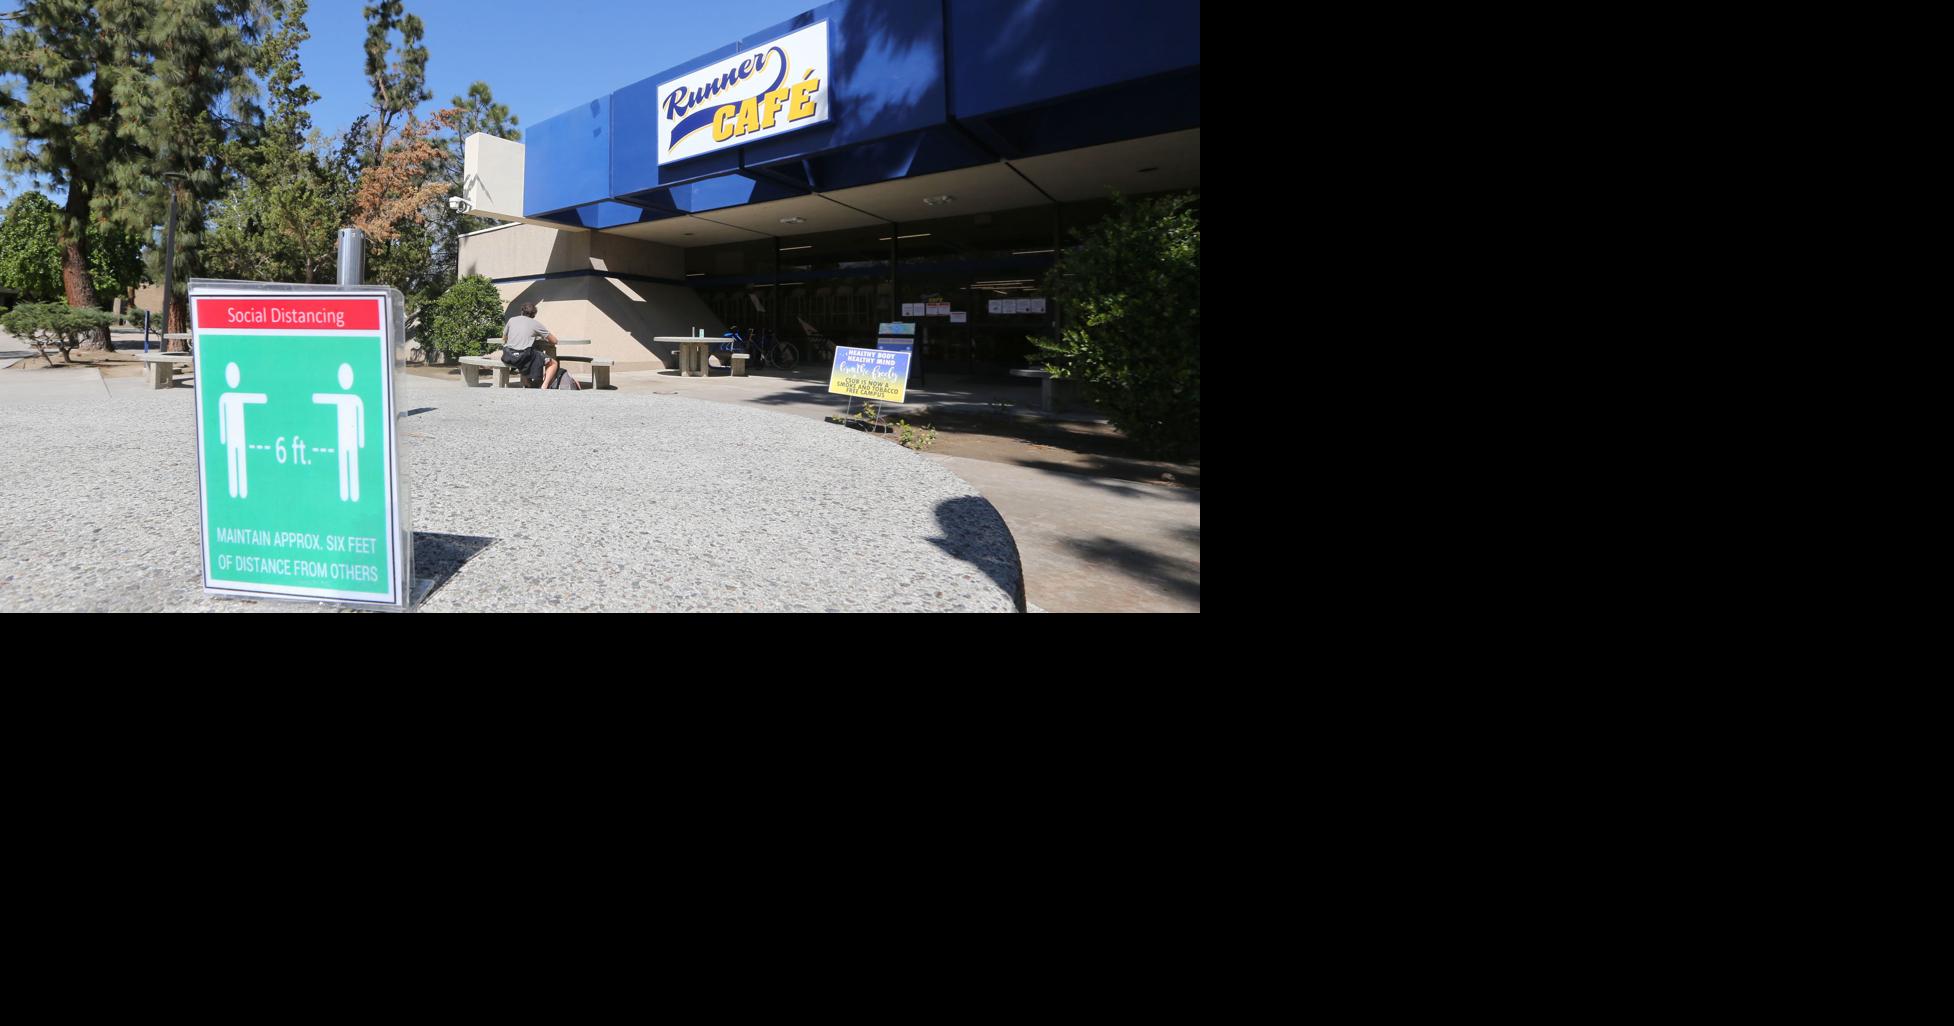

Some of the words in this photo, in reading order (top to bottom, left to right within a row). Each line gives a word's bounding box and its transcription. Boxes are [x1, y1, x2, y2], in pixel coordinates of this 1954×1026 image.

[663, 51, 768, 120] Runner
[712, 68, 820, 142] CAFÉ
[227, 307, 267, 323] Social
[271, 308, 345, 327] Distancing
[847, 356, 874, 364] HEALTHY
[868, 379, 884, 387] NOW
[872, 385, 899, 395] TOBACCO
[275, 436, 287, 464] 6
[292, 435, 312, 465] ft.
[216, 527, 271, 546] MAINTAIN
[274, 532, 323, 550] APPROX.
[326, 535, 345, 552] SIX
[349, 537, 376, 554] FEET
[218, 554, 233, 570] OF
[236, 555, 291, 576] DISTANCE
[294, 560, 328, 578] FROM
[330, 563, 378, 582] OTHERS
